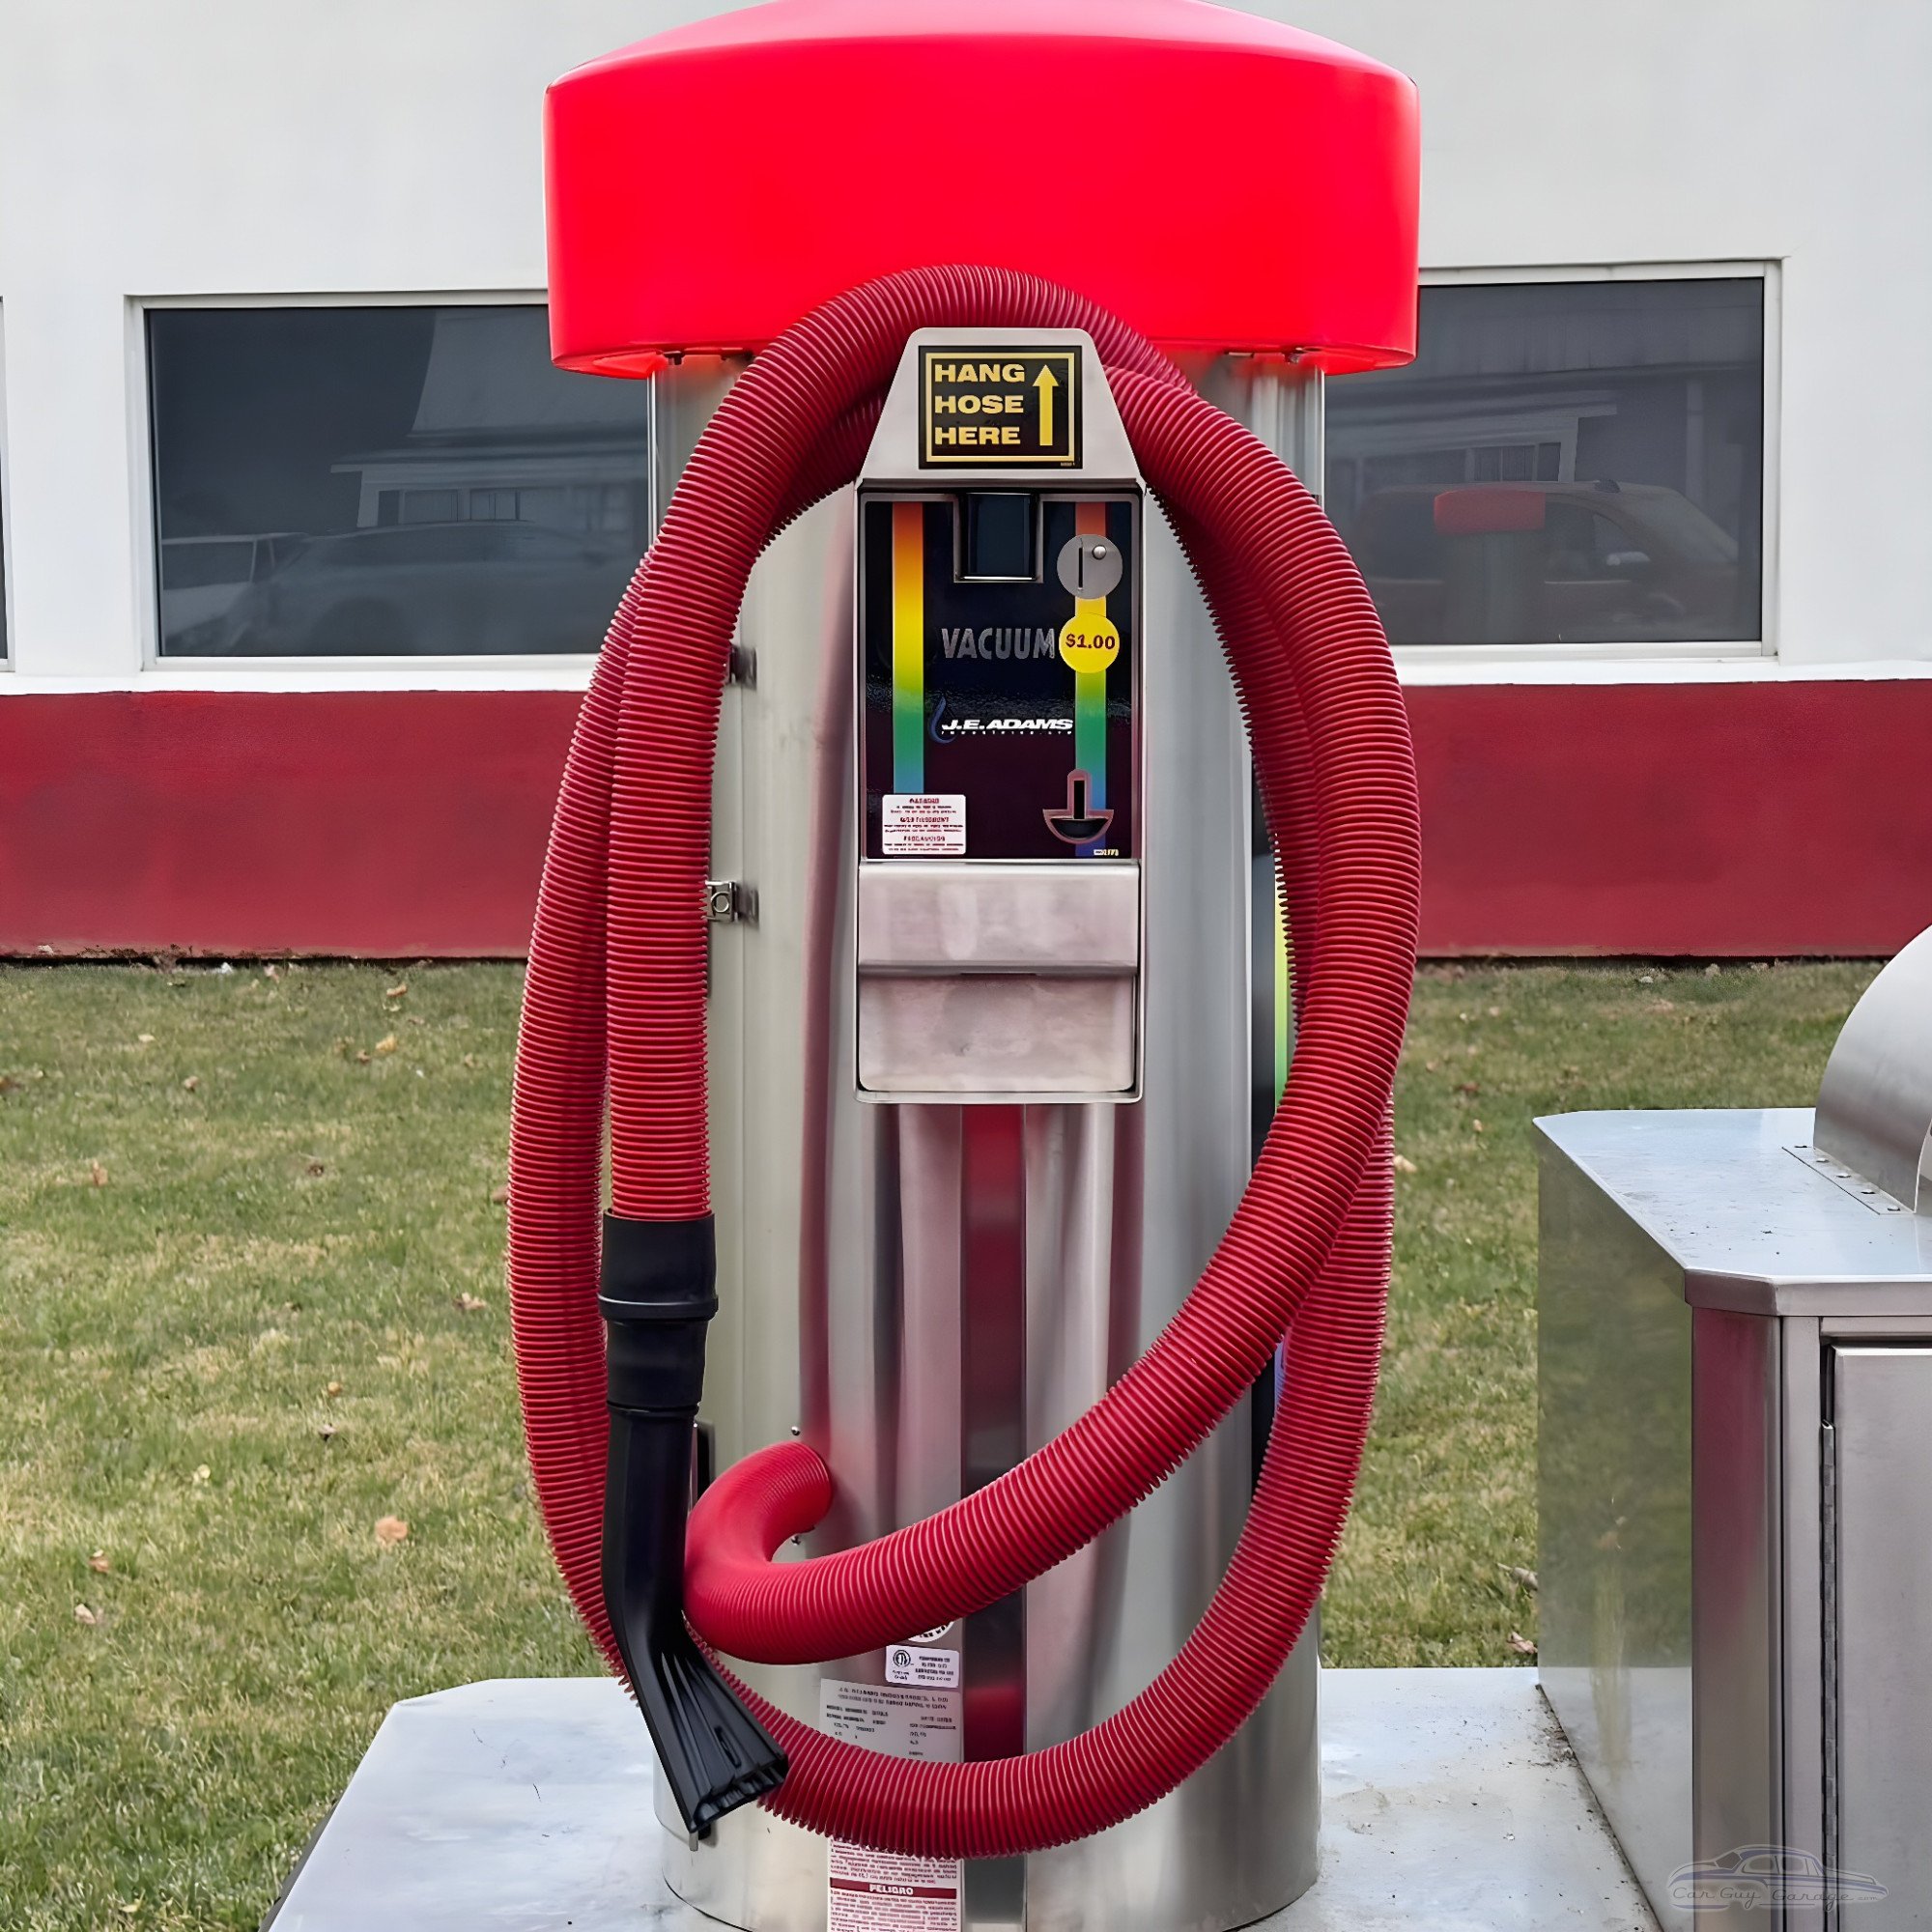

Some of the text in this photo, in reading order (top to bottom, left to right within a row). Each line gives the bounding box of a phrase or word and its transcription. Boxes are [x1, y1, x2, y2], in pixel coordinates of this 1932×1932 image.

[934, 363, 1025, 383] HANG
[934, 395, 1024, 413] HOSE
[934, 426, 1021, 444] HERE
[941, 628, 1055, 660] VACUUM
[1065, 633, 1116, 650] $1.00
